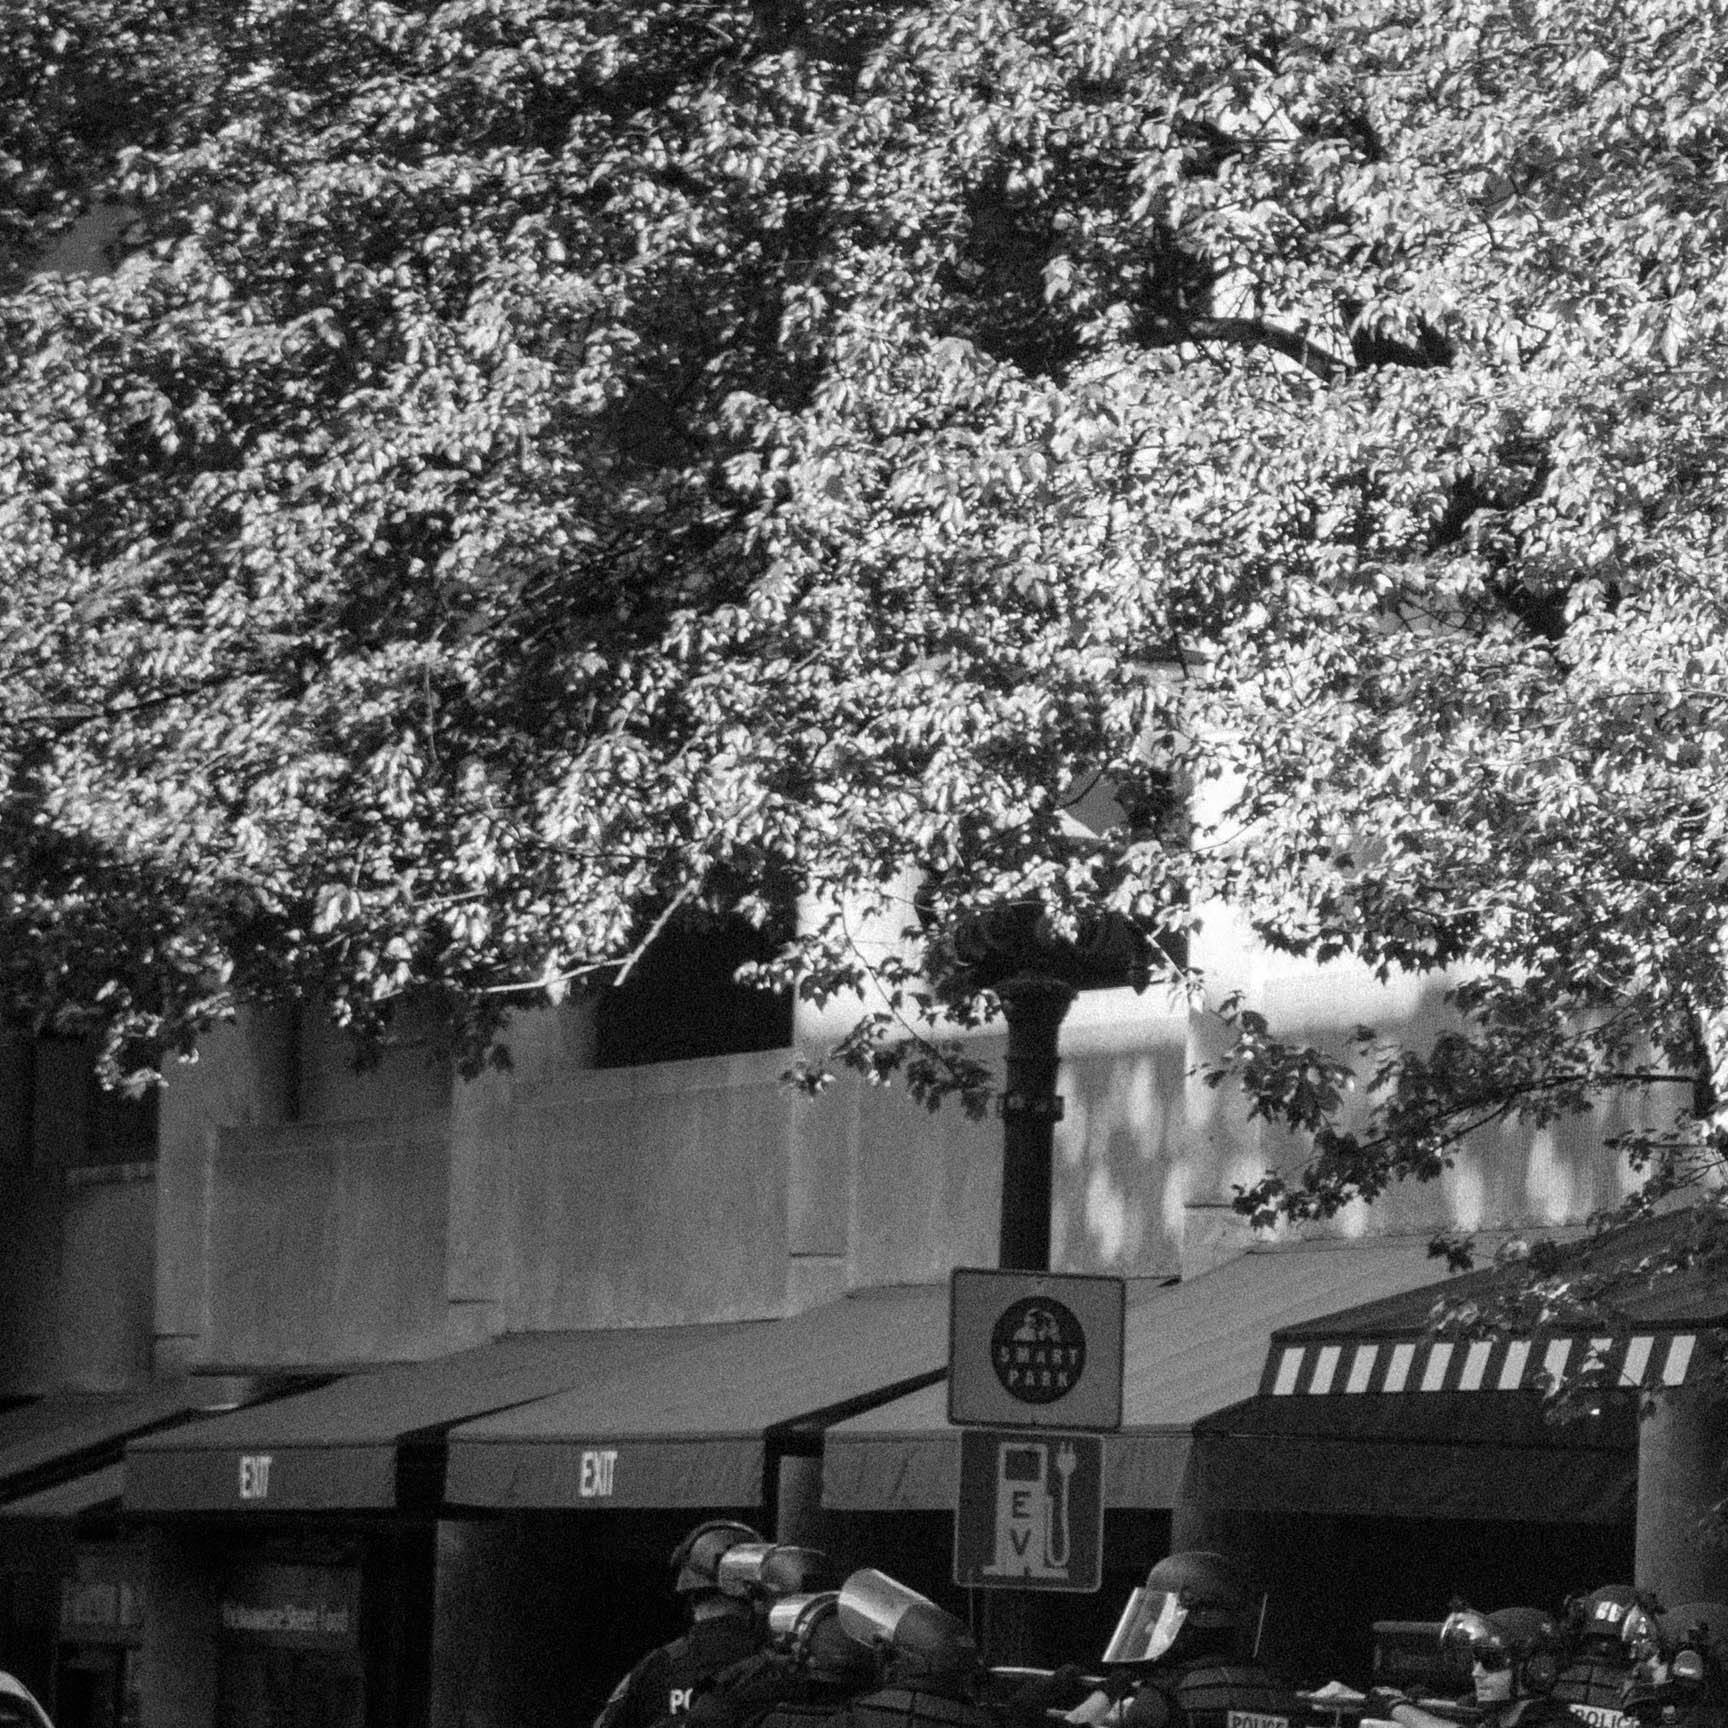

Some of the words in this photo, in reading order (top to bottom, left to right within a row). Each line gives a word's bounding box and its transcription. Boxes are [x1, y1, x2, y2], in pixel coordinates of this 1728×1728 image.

[1001, 1344, 1079, 1364] SMART
[1008, 1366, 1071, 1387] PARK
[240, 1456, 272, 1498] EXIT
[580, 1451, 618, 1497] EXIT
